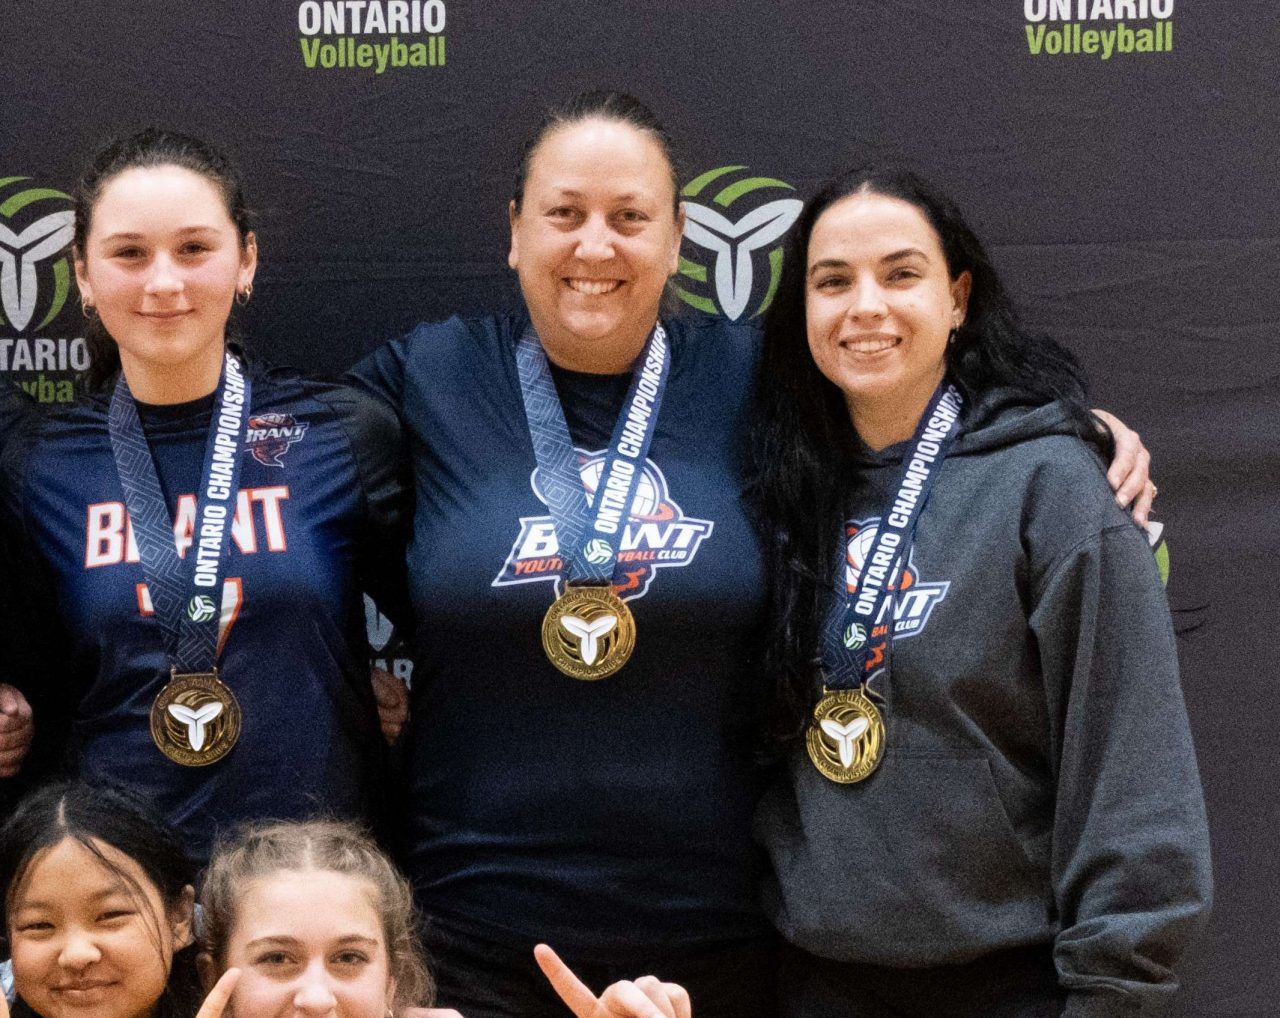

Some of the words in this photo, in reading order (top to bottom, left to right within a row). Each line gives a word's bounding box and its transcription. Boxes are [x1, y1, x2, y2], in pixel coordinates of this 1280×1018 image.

[298, 0, 446, 35] ONTARIO
[1024, 0, 1174, 22] ONTARIO
[300, 36, 446, 74] Volleyball
[1025, 21, 1173, 60] Volleyball
[207, 353, 246, 500] CHAMPIONSHIPS
[594, 458, 635, 534] ONTARIO
[854, 531, 901, 615] ONTARIO
[887, 384, 964, 528] CHAMPIONSHIPS
[194, 505, 227, 587] ONTARIO
[518, 523, 705, 560] BNT
